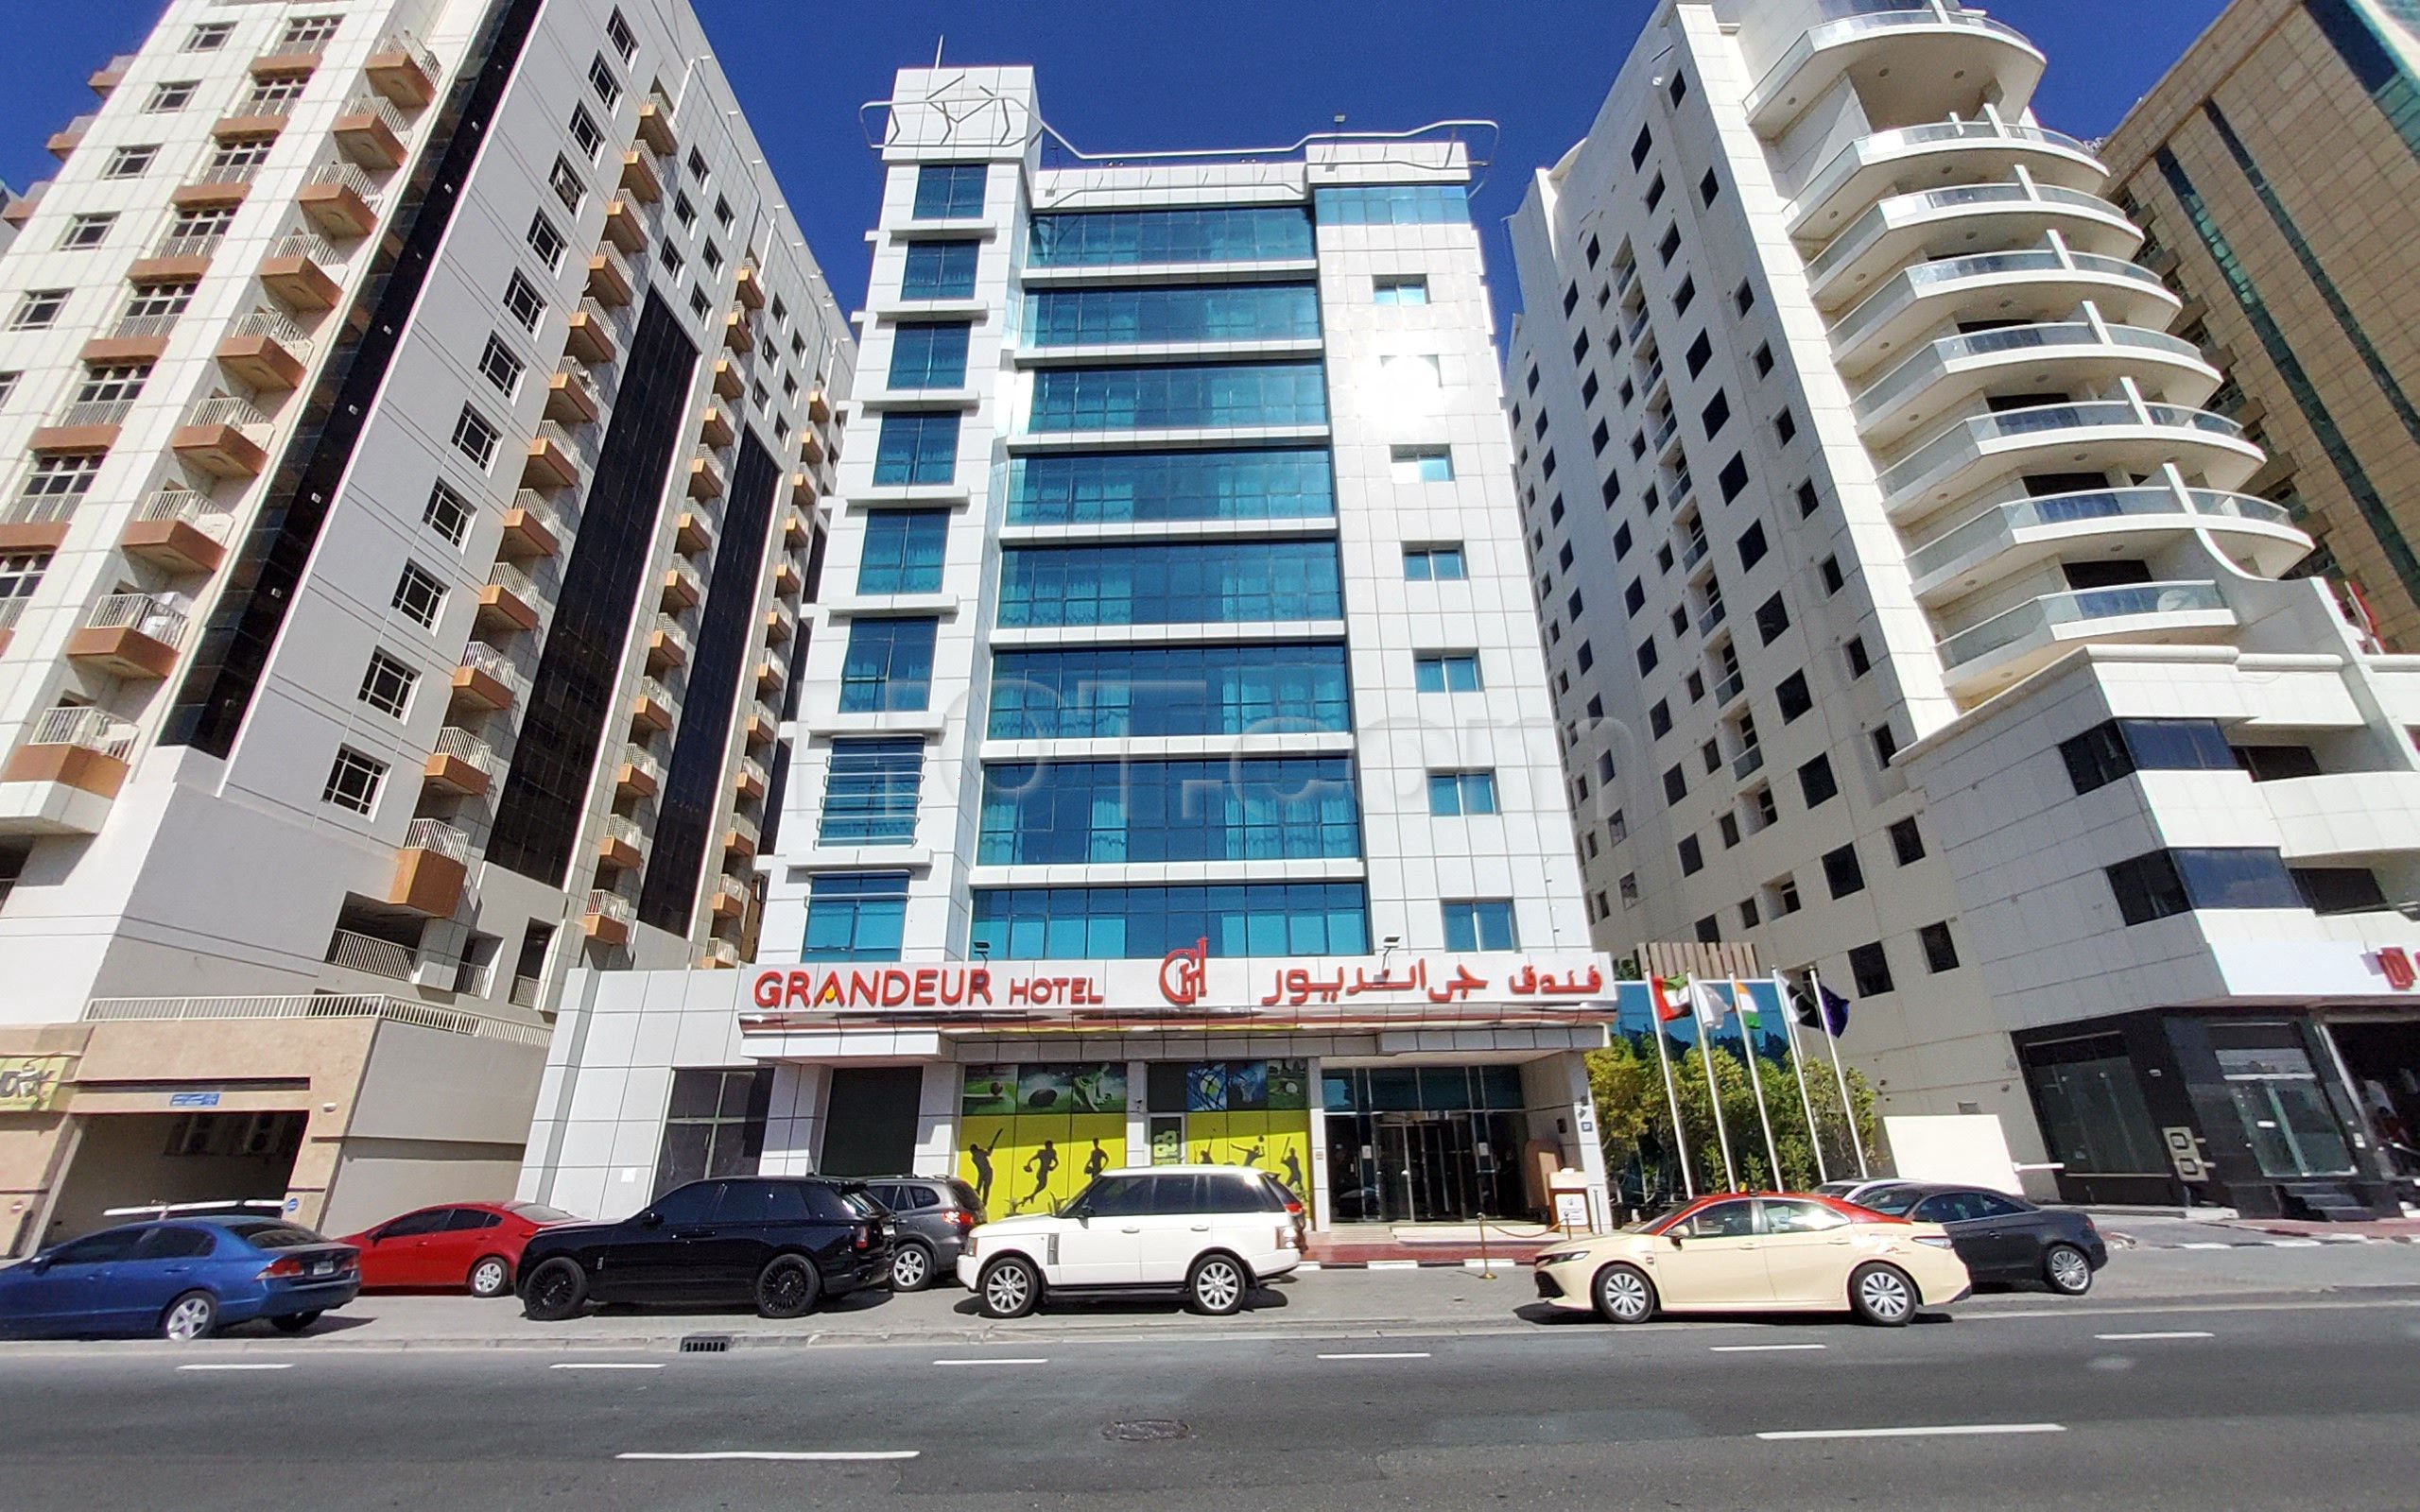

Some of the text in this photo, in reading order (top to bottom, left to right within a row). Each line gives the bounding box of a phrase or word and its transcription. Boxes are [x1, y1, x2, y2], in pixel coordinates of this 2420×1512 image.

[753, 968, 1104, 1008] GRANDEUR HOTEL
[1509, 964, 1603, 995] فندق
